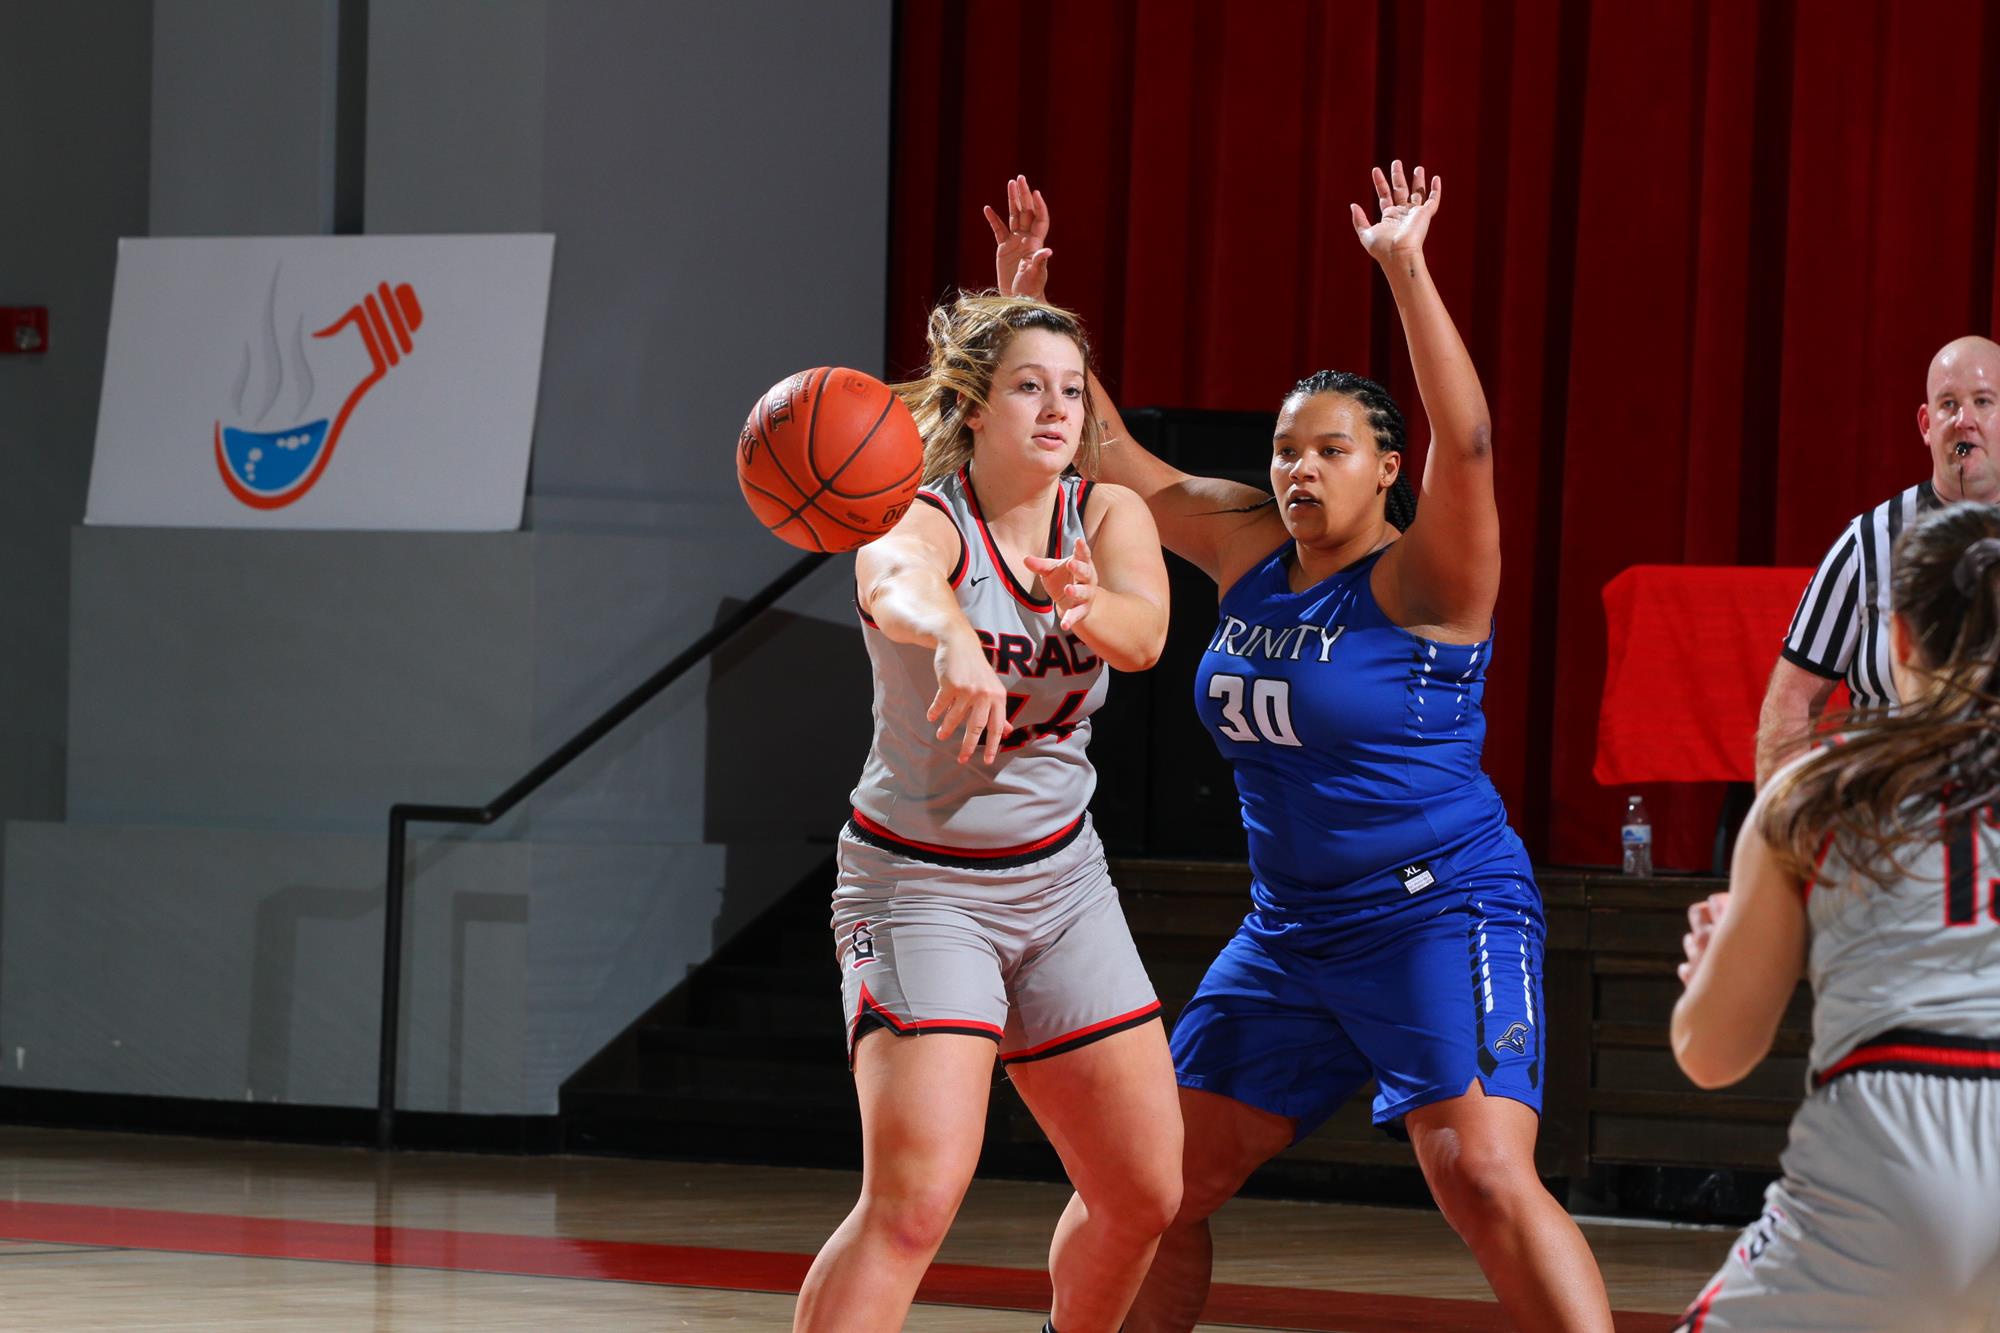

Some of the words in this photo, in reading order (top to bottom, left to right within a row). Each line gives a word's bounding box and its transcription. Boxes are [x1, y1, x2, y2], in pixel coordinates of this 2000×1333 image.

[975, 629, 1104, 679] GRAC
[1208, 673, 1303, 747] 30
[1403, 865, 1421, 878] XL
